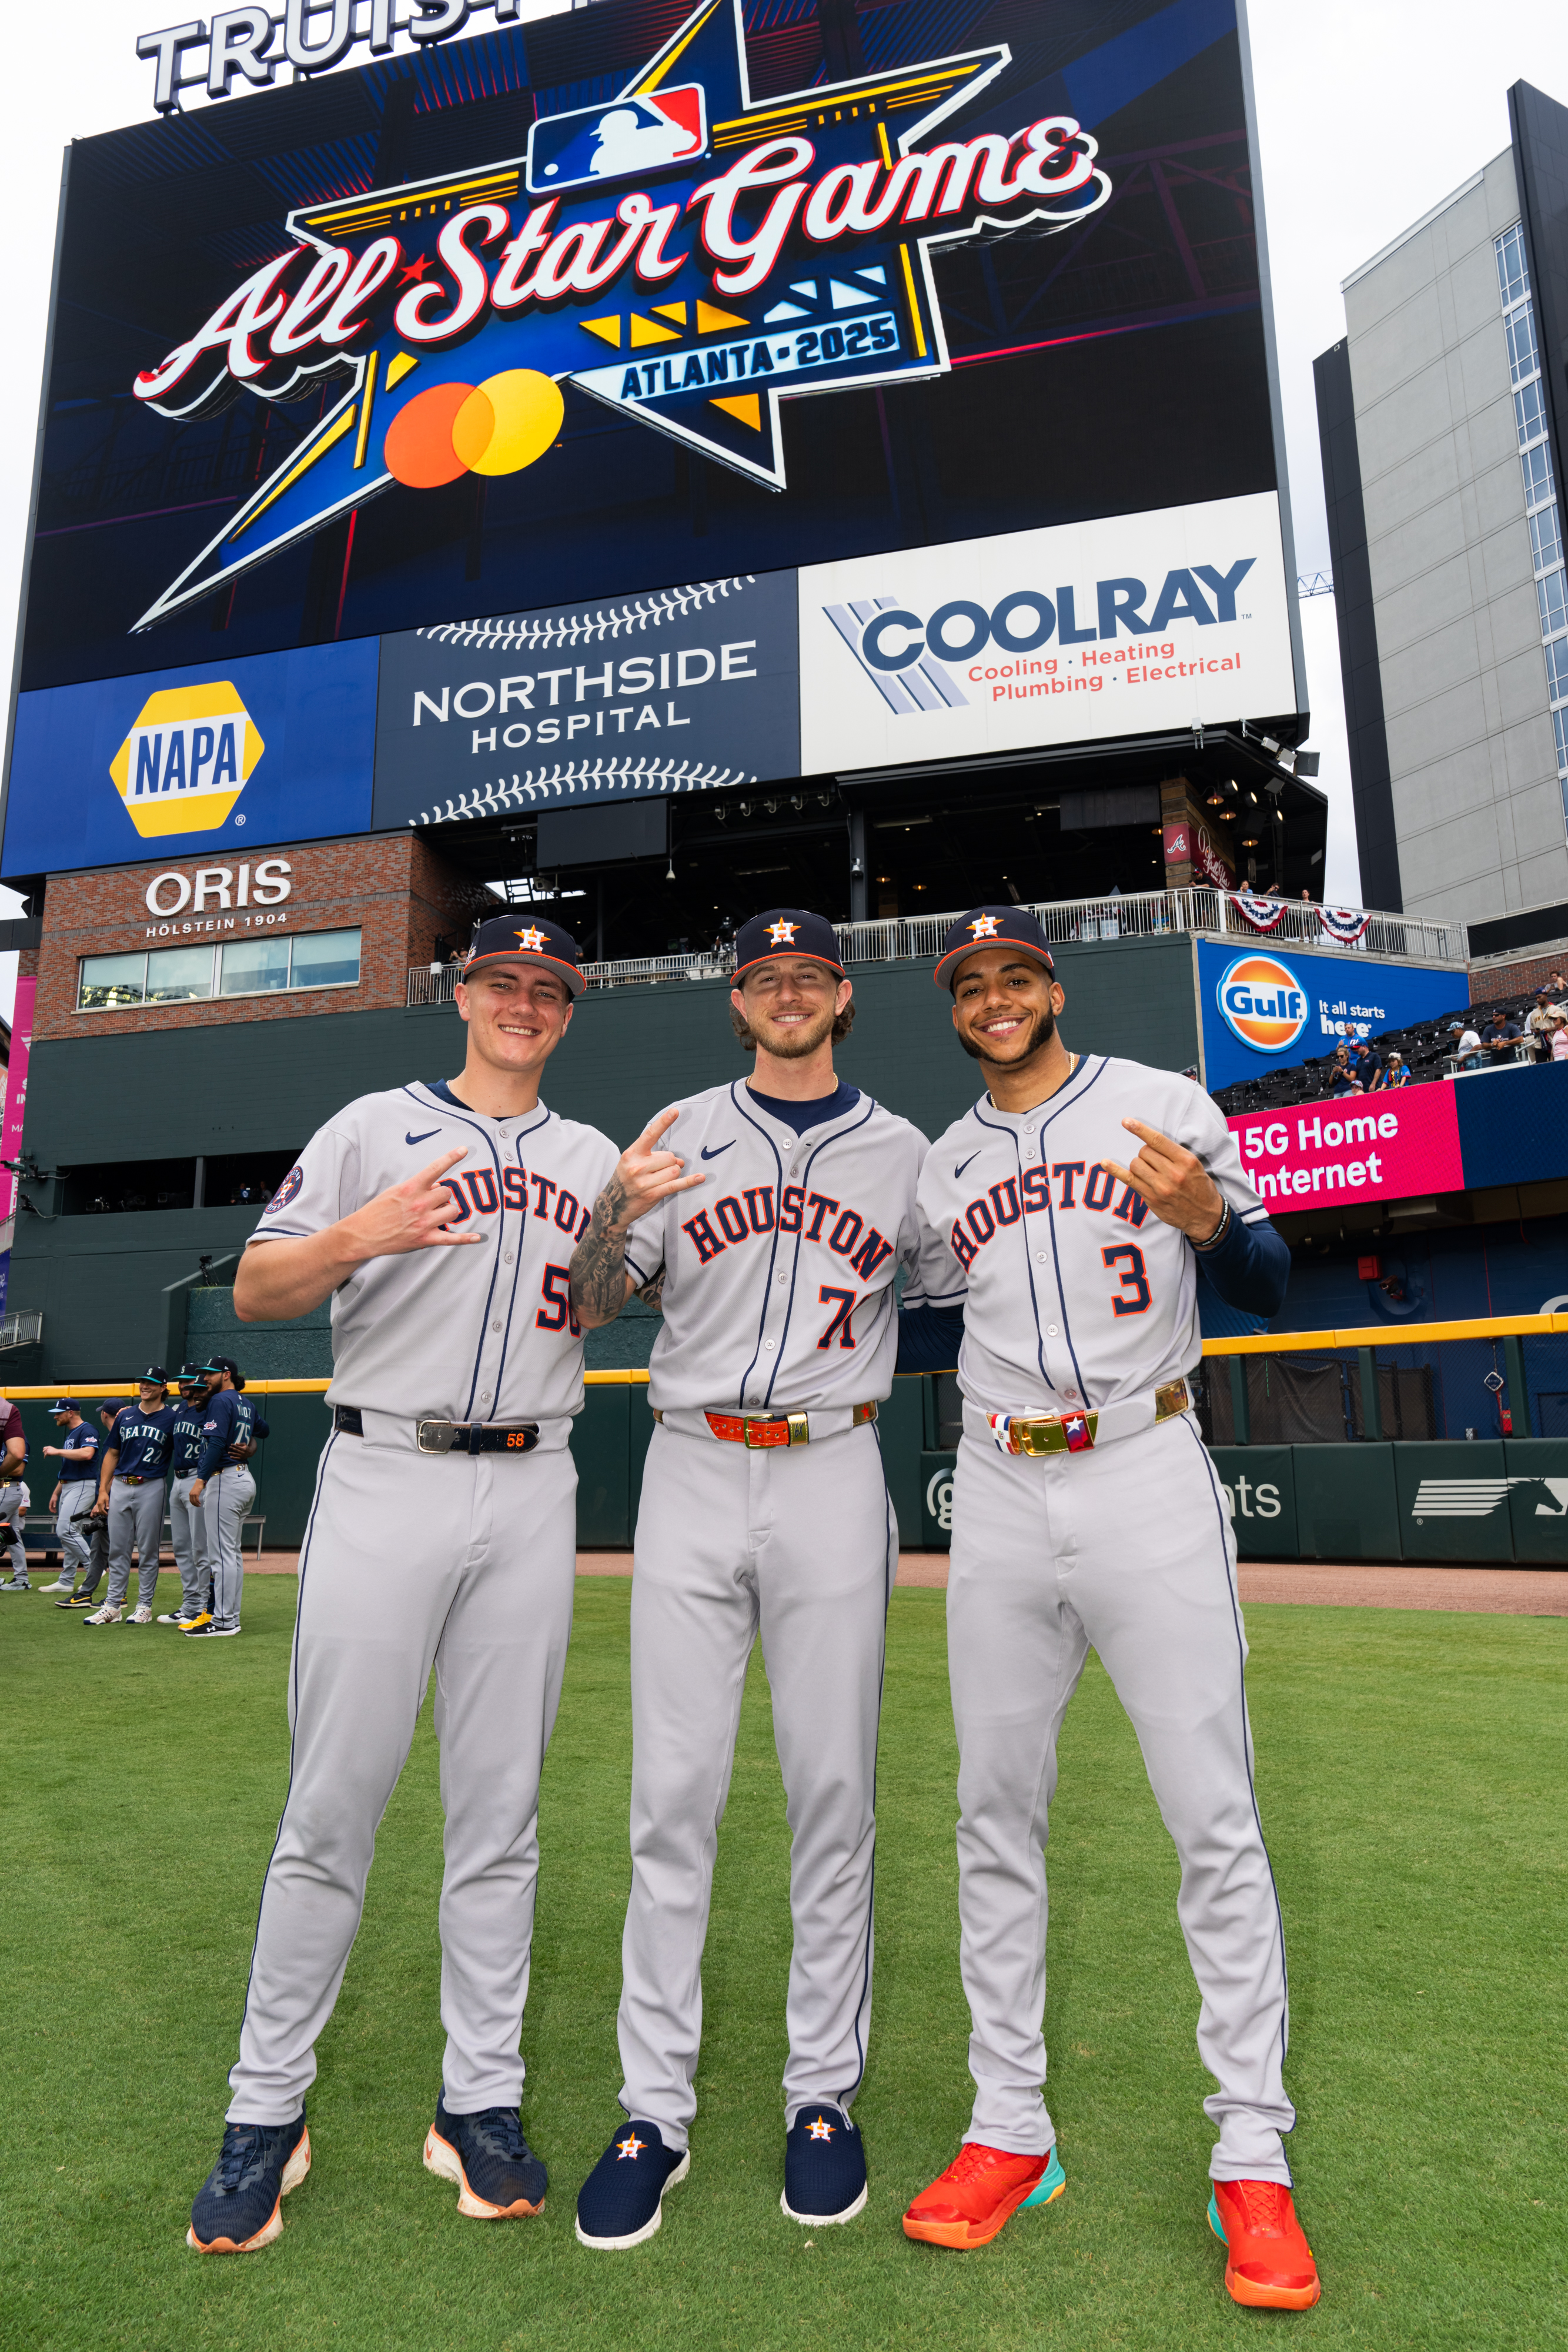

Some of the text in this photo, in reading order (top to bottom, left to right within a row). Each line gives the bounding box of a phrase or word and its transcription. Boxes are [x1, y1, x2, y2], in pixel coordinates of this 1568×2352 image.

[136, 0, 520, 113] TRUI
[132, 116, 1094, 400] All Star Game
[621, 316, 897, 399] ATLANTA 2025
[862, 557, 1257, 671] COOLRAY
[413, 640, 757, 726] NORTHSIDE
[968, 643, 1175, 681] Cooling Heating
[992, 652, 1241, 701] Plumbing Electrical
[472, 701, 690, 753] HOSPITAL
[135, 722, 237, 796] NAPA
[146, 859, 291, 917] ORIS
[146, 913, 287, 937] HÖLSTEIN 1904
[1226, 986, 1300, 1019] Gulf
[1319, 1000, 1385, 1019] It all starts
[1298, 1112, 1398, 1151] Home
[1248, 1151, 1383, 1198] Internet
[436, 1165, 592, 1245] OUSTO
[951, 1160, 1151, 1274] HOUSTON
[681, 1184, 894, 1282] HOUSTON
[1101, 1242, 1152, 1318] 3
[119, 1425, 168, 1445] SEATTLE
[142, 1447, 163, 1464] 22
[173, 1421, 203, 1440] EATTLE
[235, 1420, 251, 1445] 75
[507, 1432, 524, 1448] 58
